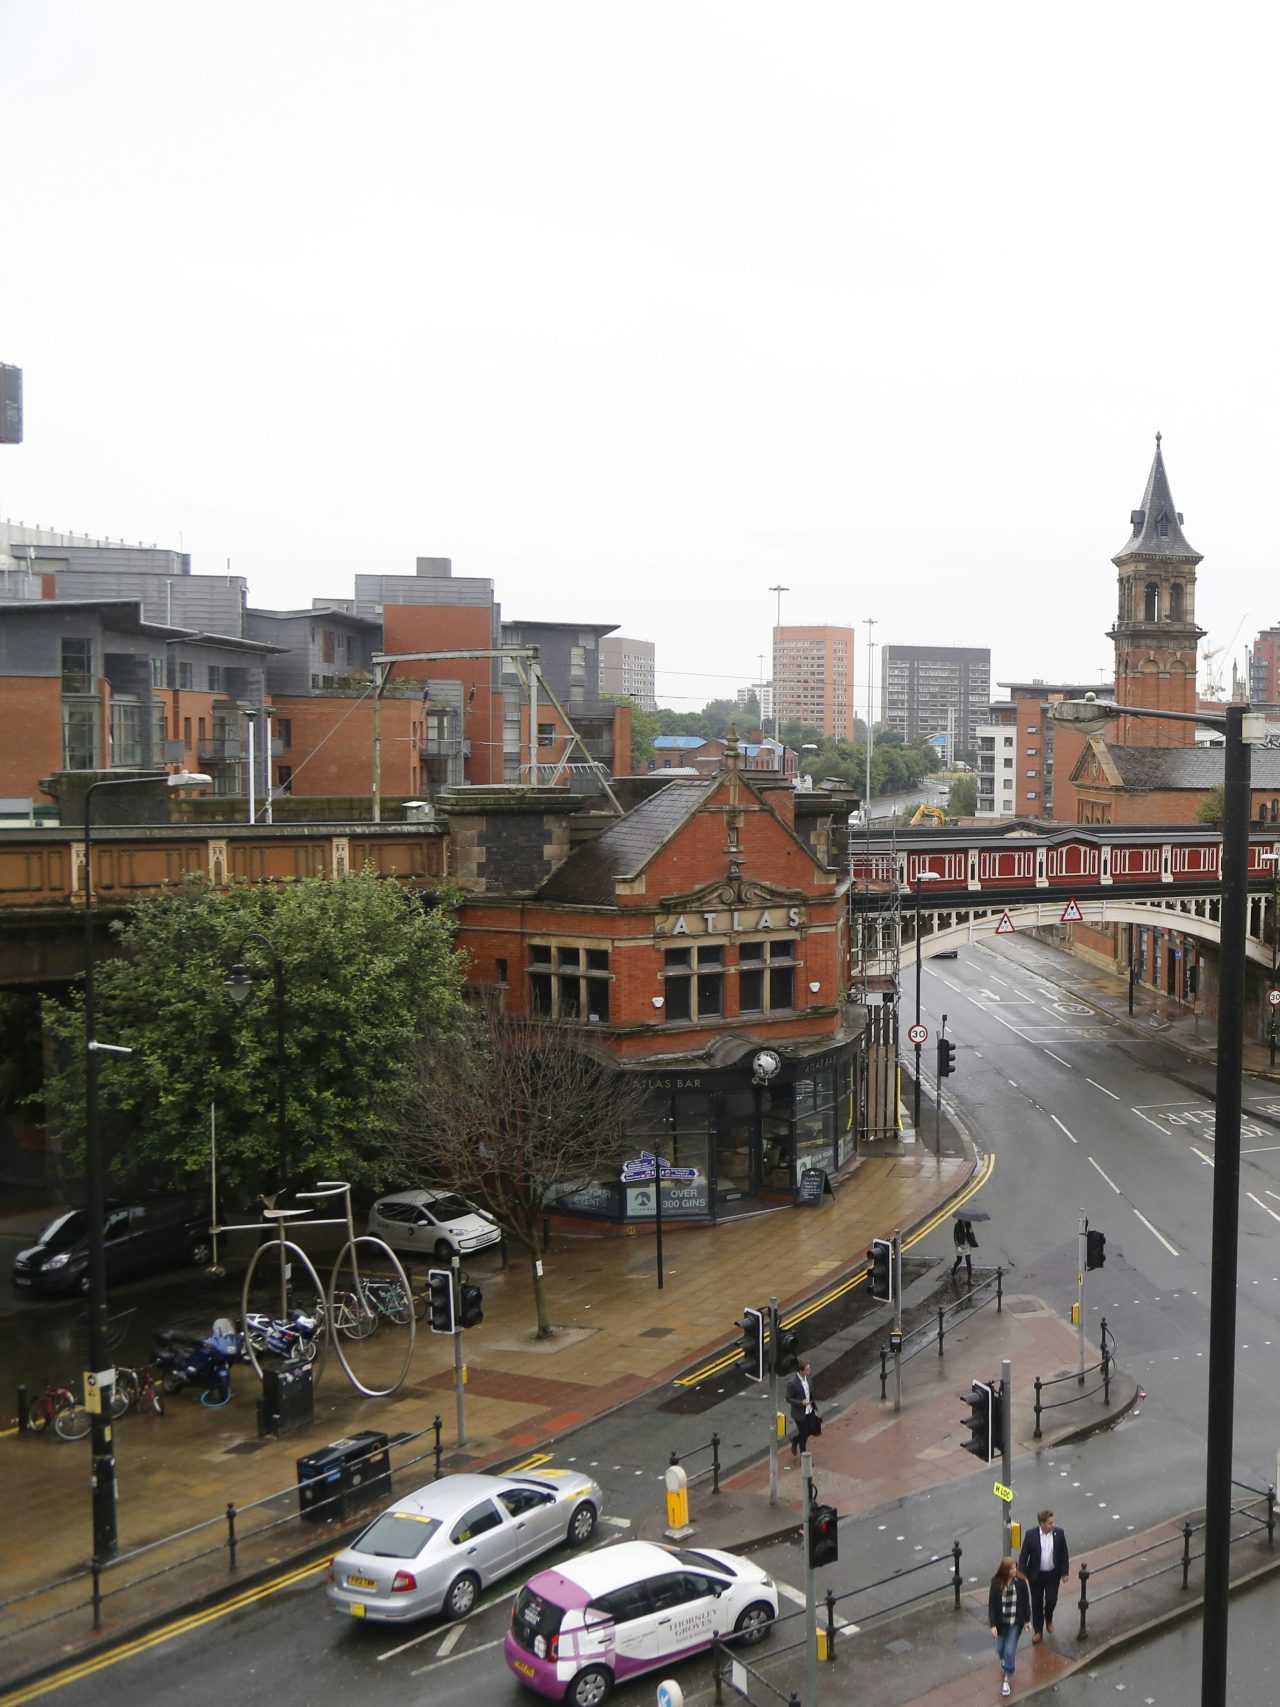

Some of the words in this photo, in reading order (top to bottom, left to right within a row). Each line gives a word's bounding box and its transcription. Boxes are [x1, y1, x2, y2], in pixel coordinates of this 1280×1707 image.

[672, 907, 801, 935] ATLAS
[1270, 993, 1280, 1001] 30
[912, 1030, 926, 1039] 30
[632, 1079, 672, 1089] ATLAS
[677, 1079, 702, 1088] BAR
[670, 1189, 698, 1198] OVER
[574, 1194, 600, 1206] EVENT
[662, 1200, 680, 1208] 300
[682, 1199, 706, 1207] GINS
[669, 1608, 718, 1631] THORNLEY
[675, 1619, 712, 1637] GROVES
